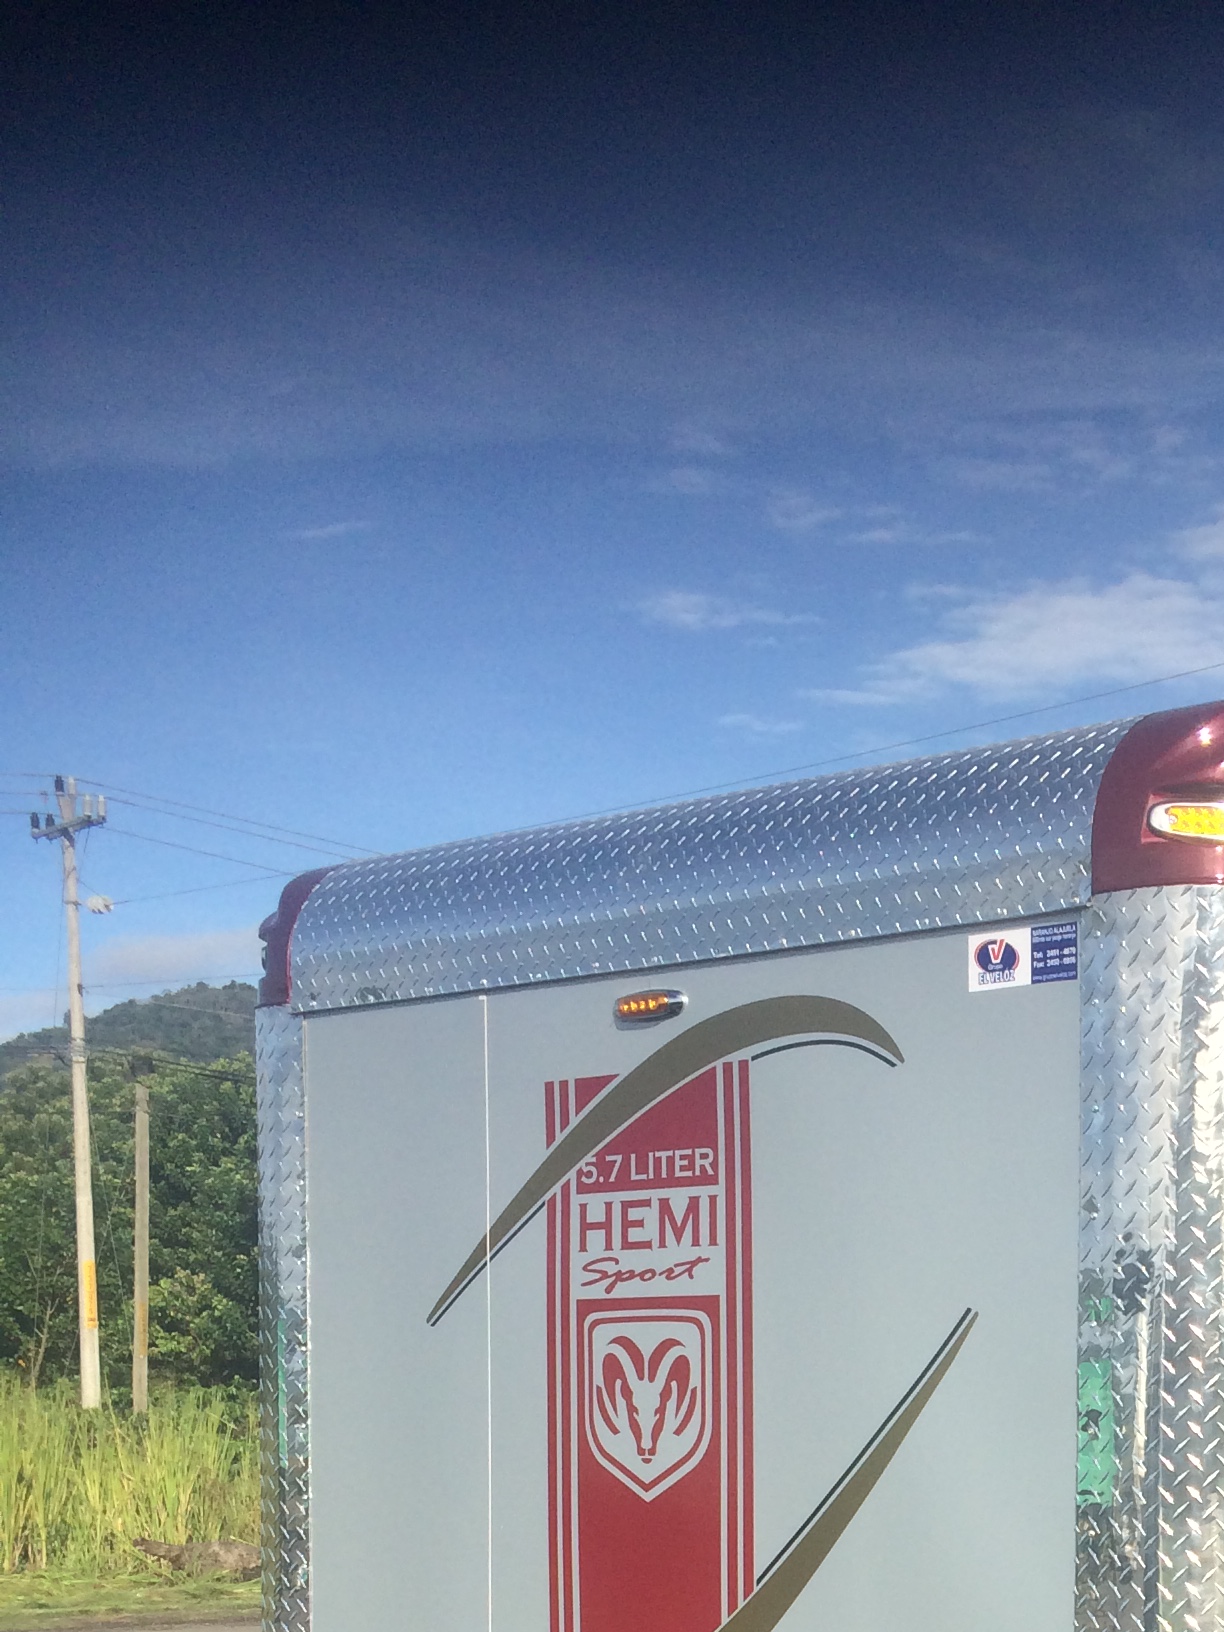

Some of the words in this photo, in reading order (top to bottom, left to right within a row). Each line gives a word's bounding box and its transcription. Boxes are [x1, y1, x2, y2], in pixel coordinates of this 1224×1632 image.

[978, 972, 990, 985] EL
[581, 1153, 623, 1184] 5.7
[630, 1147, 716, 1181] LITER
[578, 1194, 720, 1252] HEMI
[580, 1256, 711, 1295] Sport
